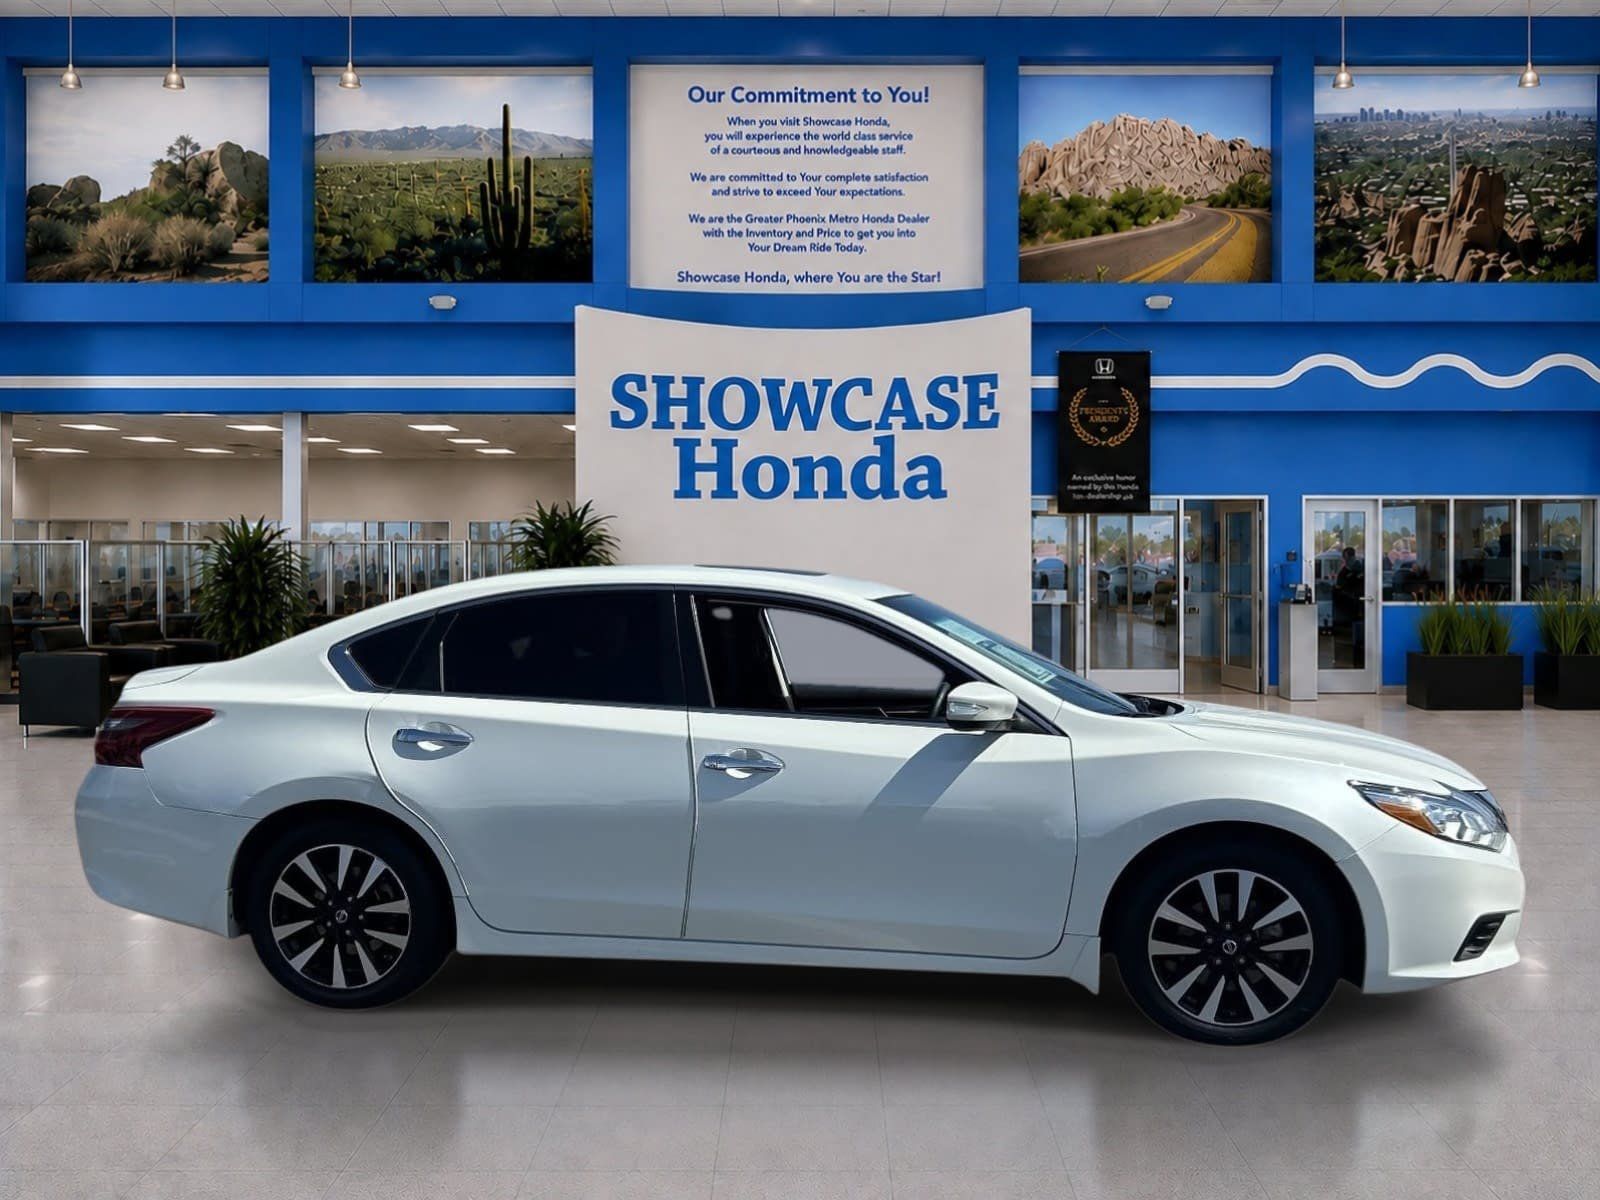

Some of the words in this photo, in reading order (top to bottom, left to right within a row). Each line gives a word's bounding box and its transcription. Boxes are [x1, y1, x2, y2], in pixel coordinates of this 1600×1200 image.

[687, 85, 726, 104] Our
[730, 86, 857, 104] Commitment
[861, 87, 883, 104] to
[887, 86, 929, 104] You!
[726, 116, 757, 126] When
[758, 118, 778, 129] you
[779, 116, 801, 127] visit
[802, 116, 853, 127] Showcase
[854, 116, 891, 128] Honda,
[704, 133, 724, 144] you
[725, 130, 743, 141] will
[745, 130, 801, 144] experience
[803, 130, 820, 141] the
[822, 130, 851, 141] world
[853, 130, 877, 141] class
[878, 130, 914, 141] service
[710, 144, 721, 155] of
[722, 147, 729, 155] a
[730, 146, 781, 156] courteous
[782, 144, 802, 155] and
[881, 144, 906, 155] staff.
[689, 171, 708, 183] We
[709, 174, 726, 183] are
[728, 171, 784, 183] committed
[786, 173, 798, 183] to
[799, 171, 823, 183] Your
[824, 171, 872, 185] complete
[873, 171, 929, 183] satisfaction
[711, 185, 731, 197] and
[732, 186, 761, 197] strive
[762, 187, 774, 197] to
[775, 186, 812, 197] exceed
[814, 186, 838, 197] Your
[838, 185, 907, 200] expectations.
[688, 213, 706, 224] We
[707, 215, 725, 224] are
[726, 213, 743, 224] the
[744, 213, 784, 224] Greater
[785, 213, 826, 224] Phoenix
[828, 213, 860, 224] Metro
[861, 213, 895, 224] Honda
[897, 213, 930, 224] Dealer
[702, 227, 725, 238] with
[726, 227, 744, 238] the
[745, 227, 794, 241] Inventory
[795, 227, 814, 238] and
[816, 227, 842, 238] Price
[843, 229, 855, 239] to
[856, 229, 874, 241] get
[876, 230, 895, 241] you
[896, 227, 917, 238] into
[747, 242, 771, 253] Your
[773, 242, 807, 253] Dream
[809, 242, 832, 253] Ride
[834, 242, 867, 255] Today.
[677, 270, 741, 284] Showcase
[744, 270, 790, 286] Honda,
[793, 270, 834, 284] where
[836, 271, 861, 284] You
[863, 274, 884, 283] are
[886, 270, 908, 283] the
[911, 271, 941, 283] Star!
[609, 373, 1000, 431] SHOWCASE
[673, 434, 948, 500] Honda
